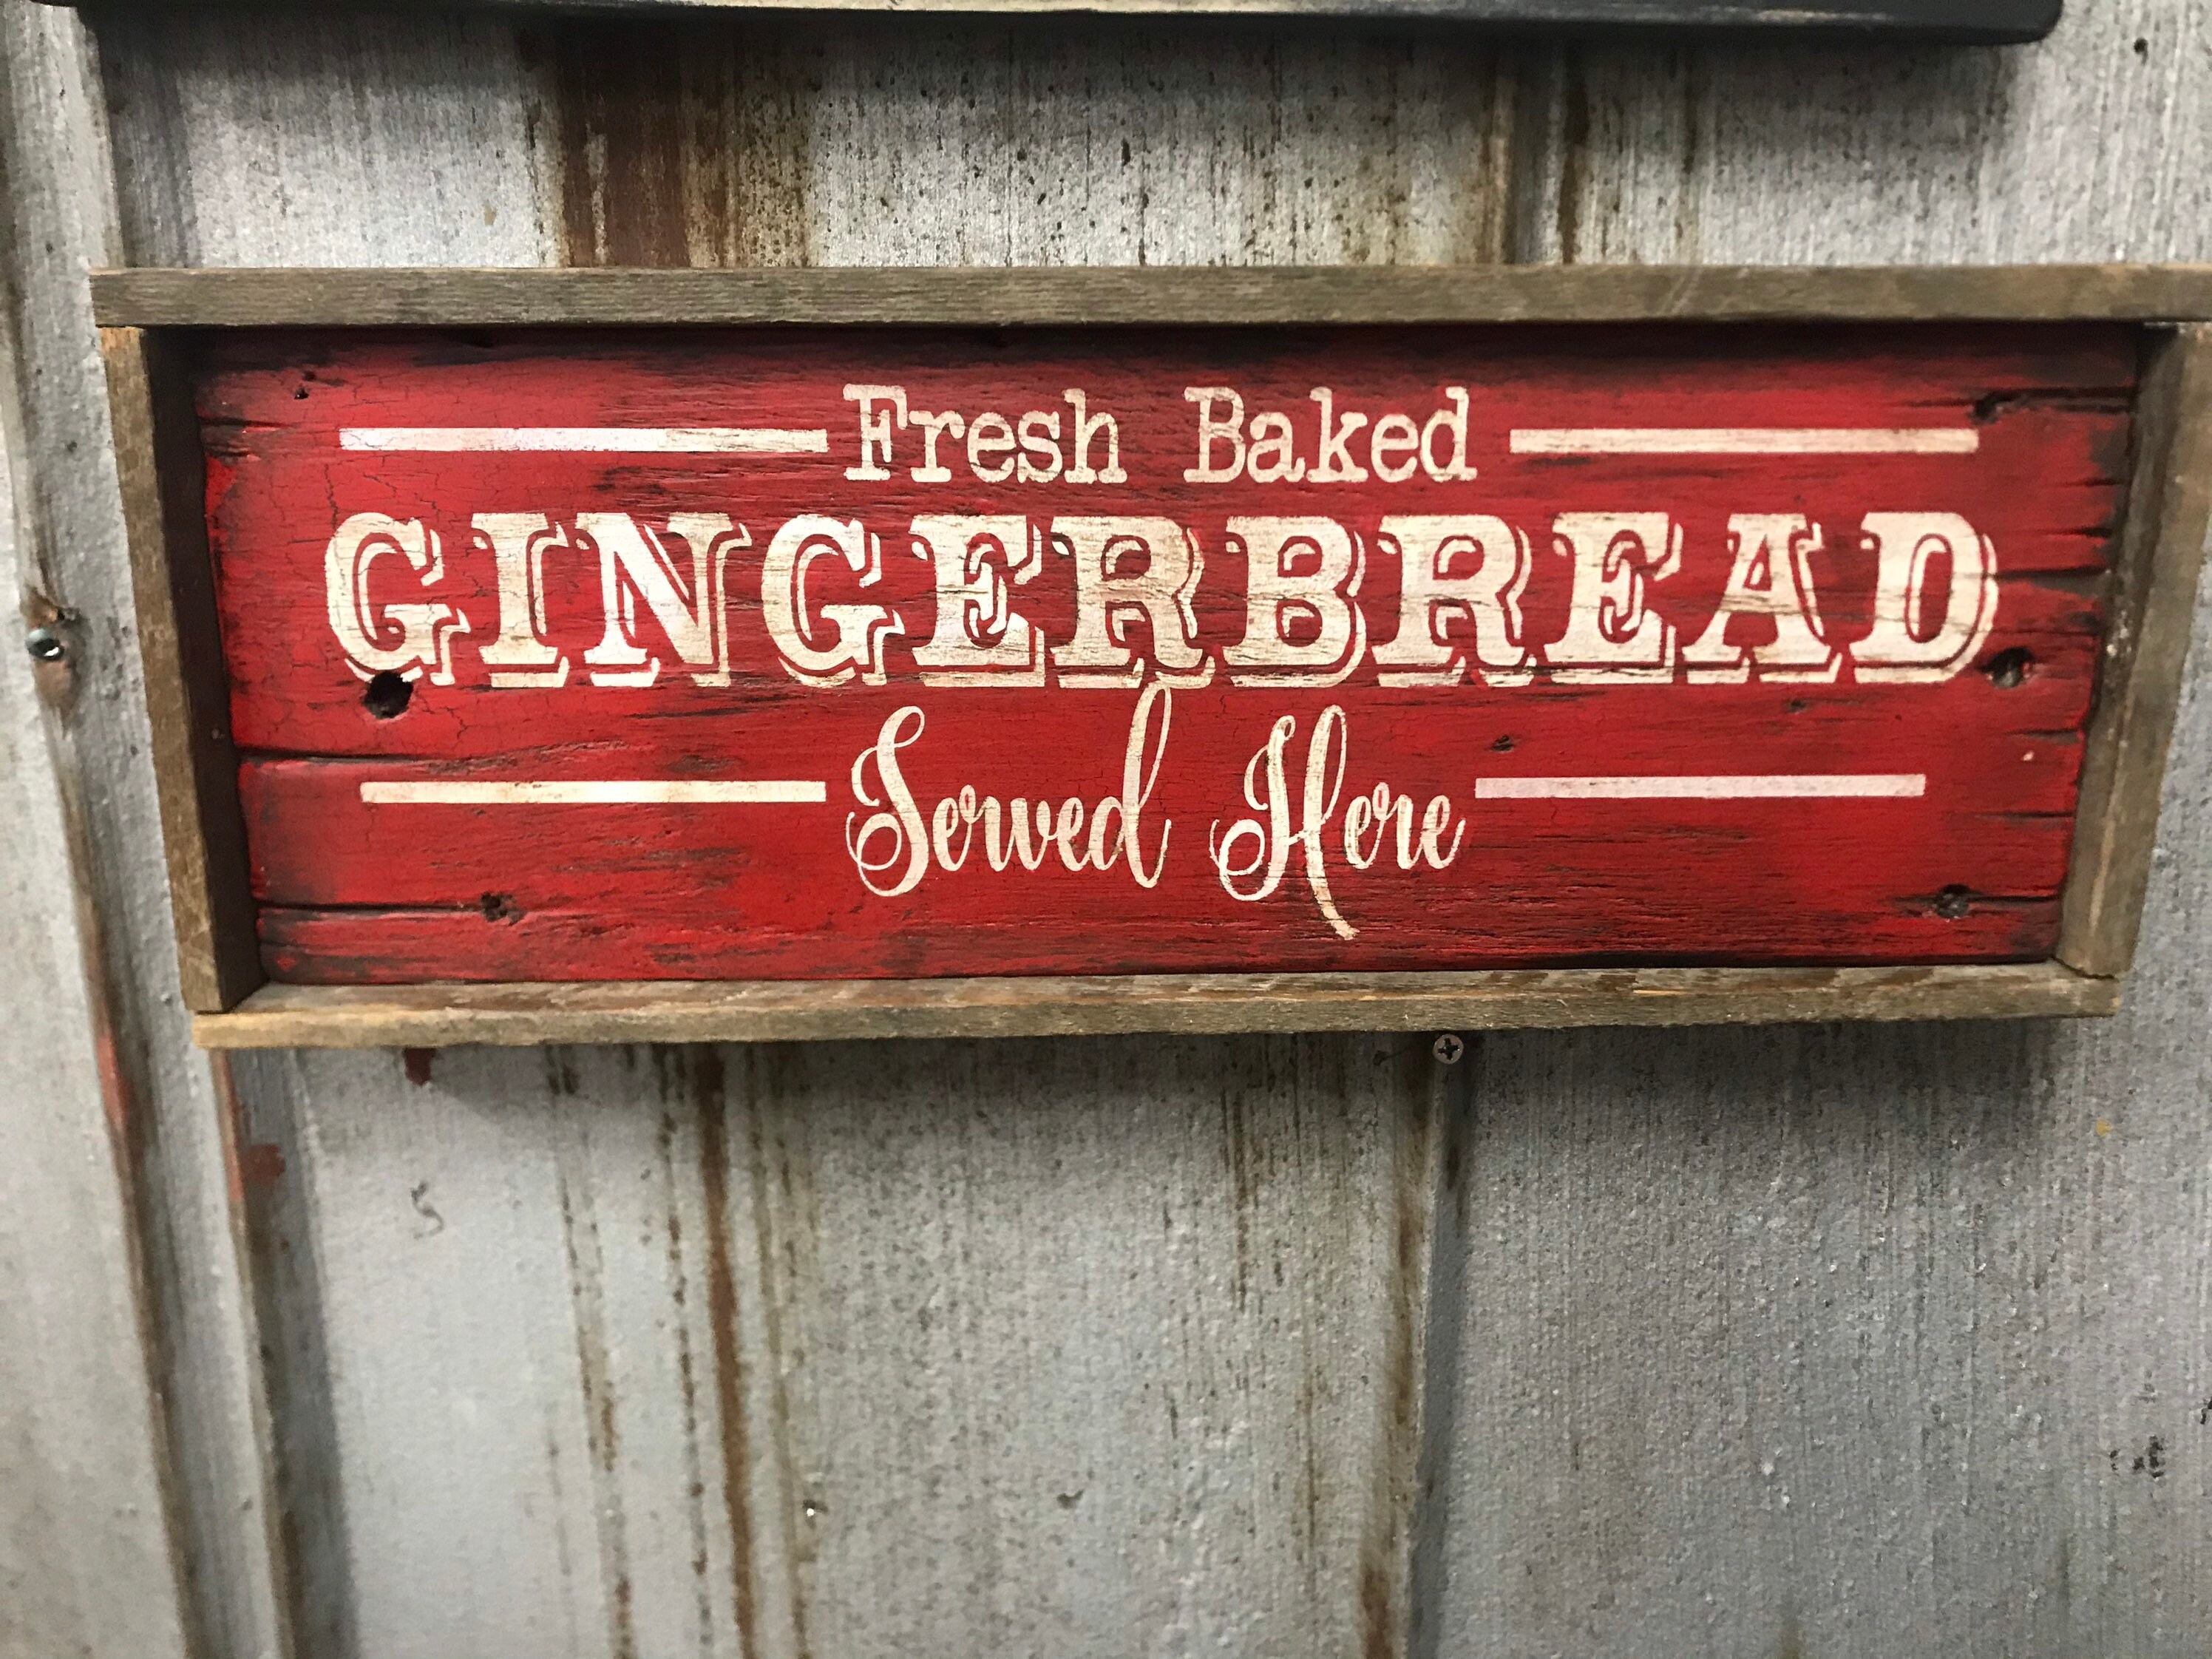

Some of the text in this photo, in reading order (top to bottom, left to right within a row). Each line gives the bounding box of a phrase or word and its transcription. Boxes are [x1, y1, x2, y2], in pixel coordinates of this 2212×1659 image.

[843, 384, 1478, 484] Fresh Baked
[325, 512, 2000, 689] GINGERBREAD
[846, 684, 1468, 940] Served Here
